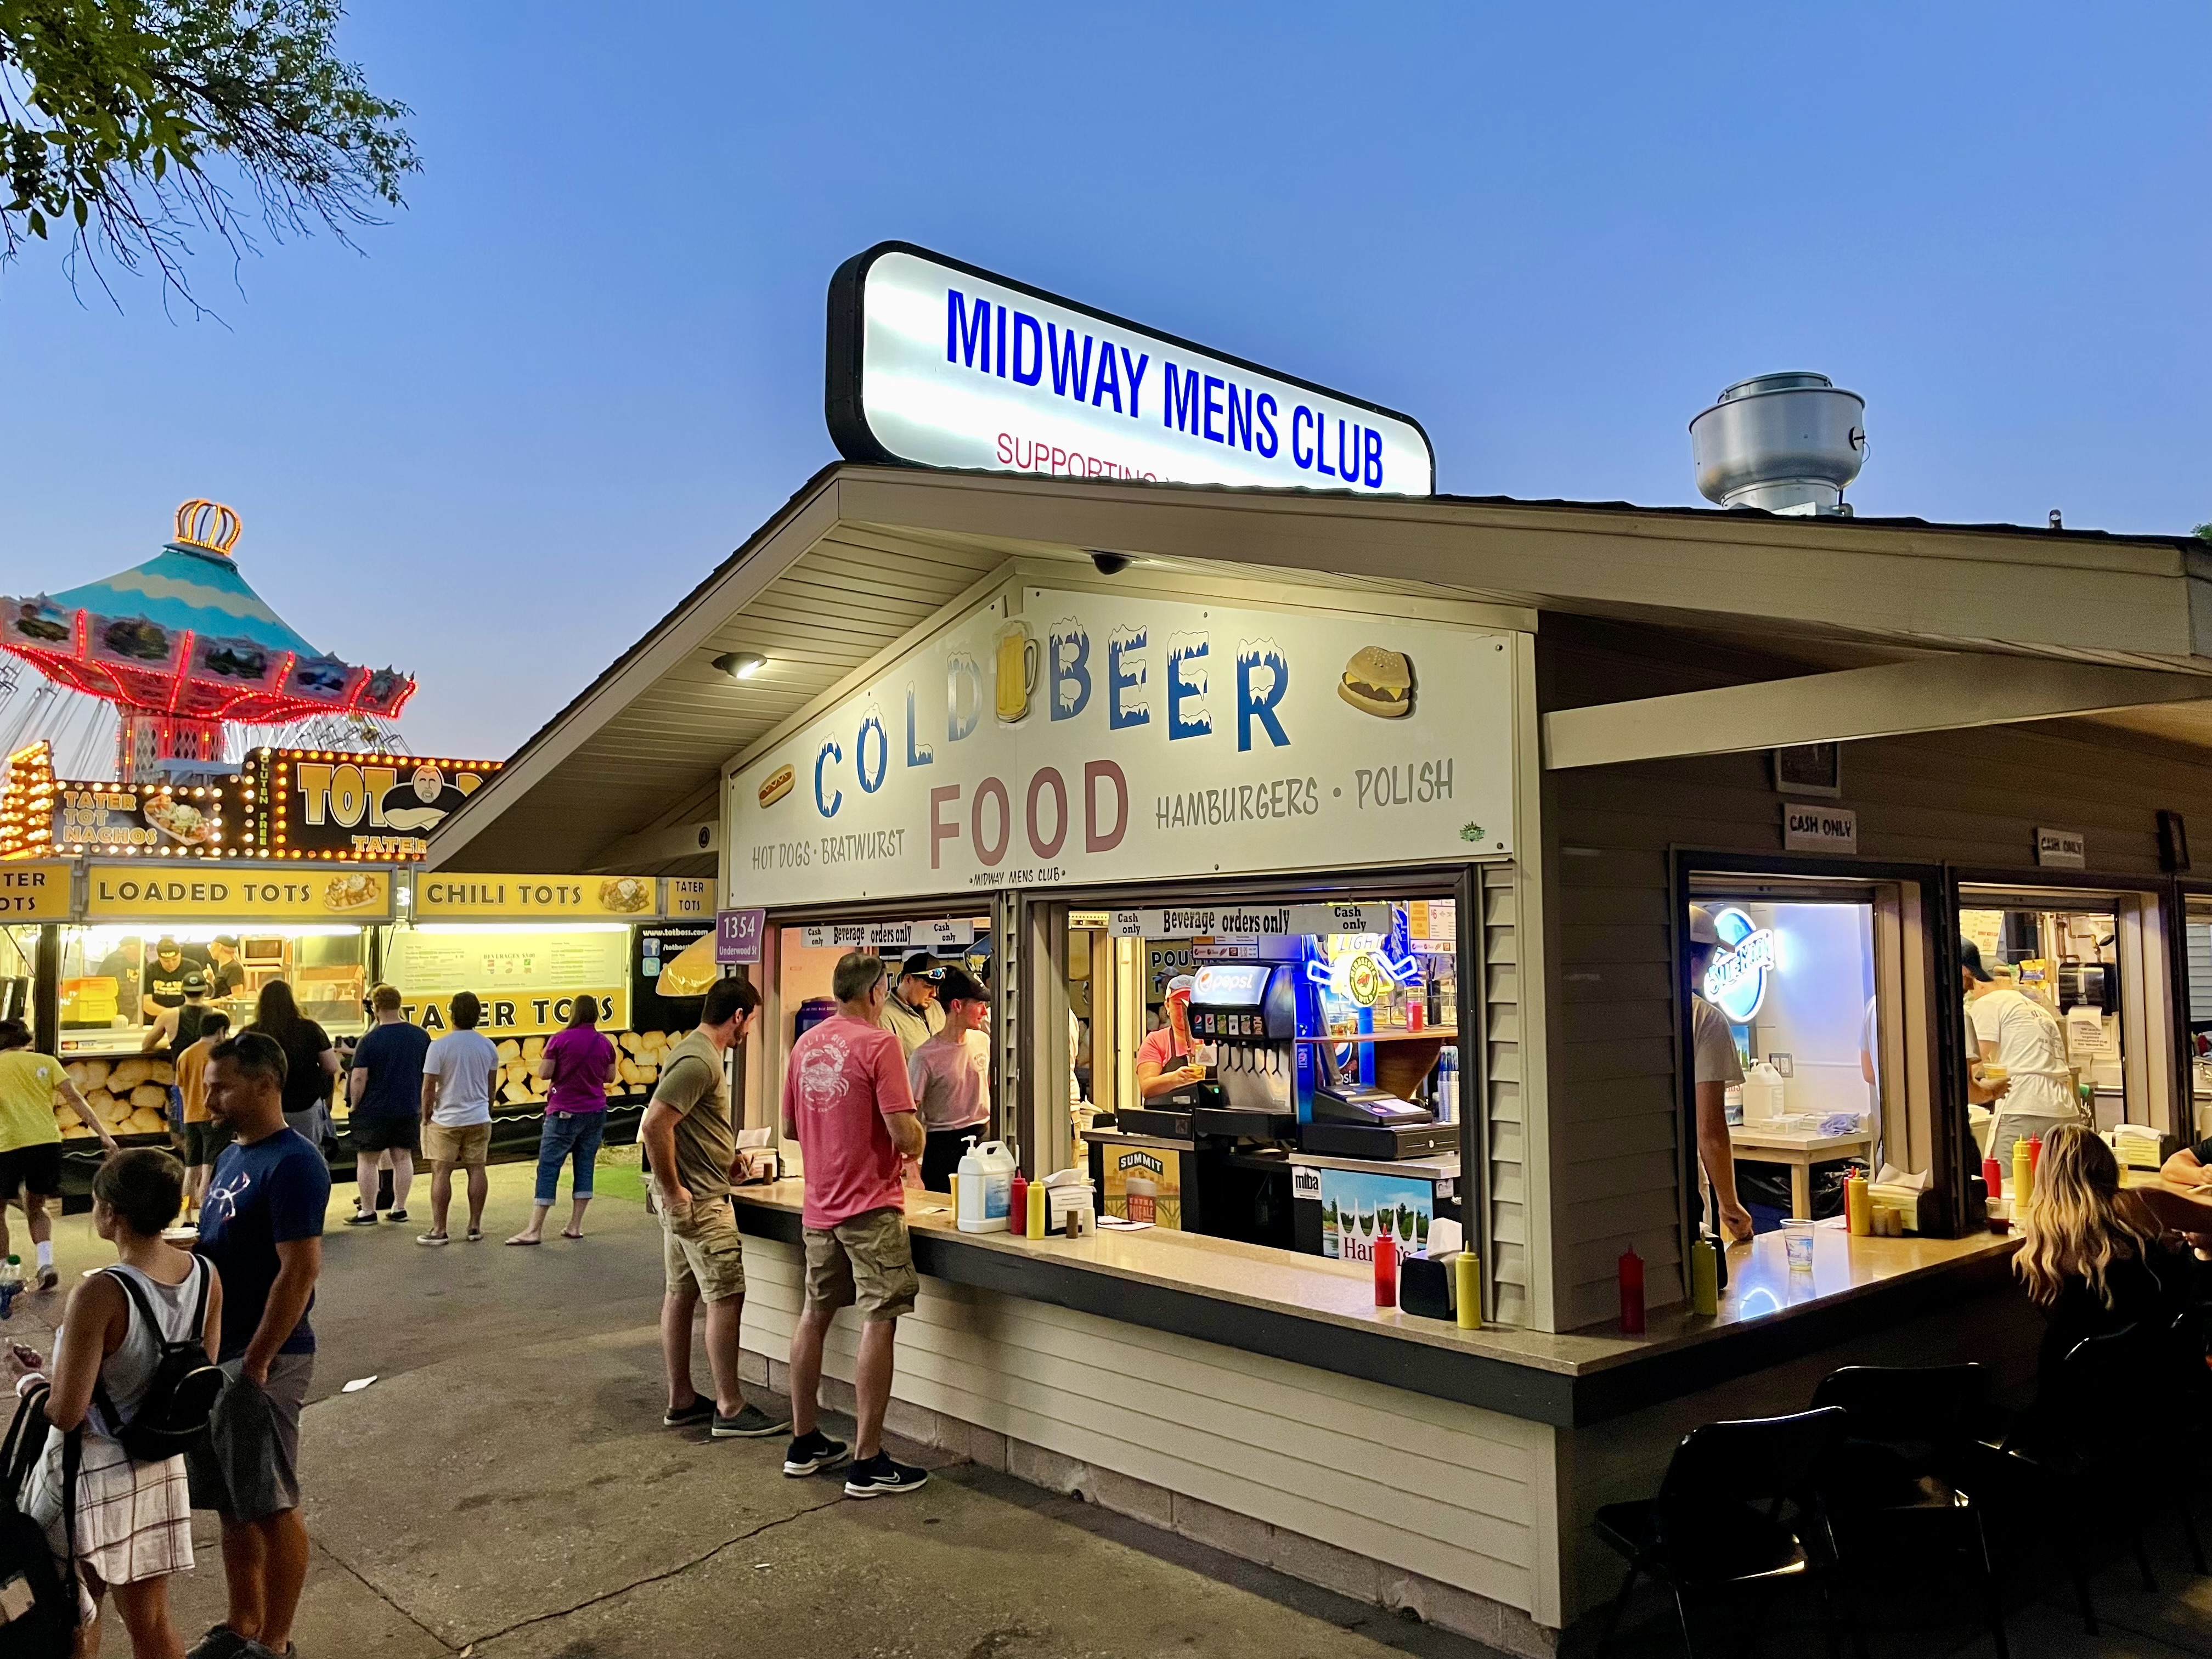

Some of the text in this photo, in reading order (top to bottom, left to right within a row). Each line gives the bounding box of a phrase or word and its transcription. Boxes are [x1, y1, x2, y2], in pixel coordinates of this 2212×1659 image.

[946, 288, 1384, 490] MIDWAY MENS CLUB
[814, 615, 1291, 818] COLD BEER
[63, 791, 137, 811] TATER
[297, 762, 397, 828] TOT
[1155, 758, 1453, 830] HAMBURGERS POLISH
[63, 808, 109, 826] TOT
[930, 759, 1128, 870] FOOD
[63, 825, 158, 845] NACHOS
[1790, 815, 1852, 838] CASH ONLY
[352, 834, 427, 854] TATER
[752, 828, 905, 870] HOT DOGS BRATWURST
[2063, 840, 2082, 855] ONLY
[676, 881, 703, 893] TATER
[973, 867, 1060, 887] MIDWAY MENS CLUB
[98, 881, 312, 904] LOADED TOTS
[426, 883, 583, 905] CHILI TOTS
[679, 900, 700, 911] TOTS
[1334, 906, 1361, 917] Cash
[724, 916, 755, 939] 1354
[934, 923, 950, 932] Cash
[1118, 913, 1138, 923] Cash
[1164, 909, 1290, 935] Beverage orders only
[1342, 918, 1367, 932] only
[643, 928, 708, 936] www.totboss.com
[808, 928, 821, 936] Cash
[833, 924, 911, 945] Beverage orders only
[942, 933, 956, 942] only
[1122, 923, 1141, 935] only
[719, 945, 757, 955] Underwood St
[812, 937, 823, 946] only
[401, 995, 614, 1030] TAER TOS
[1120, 1153, 1161, 1172] SUMMIT
